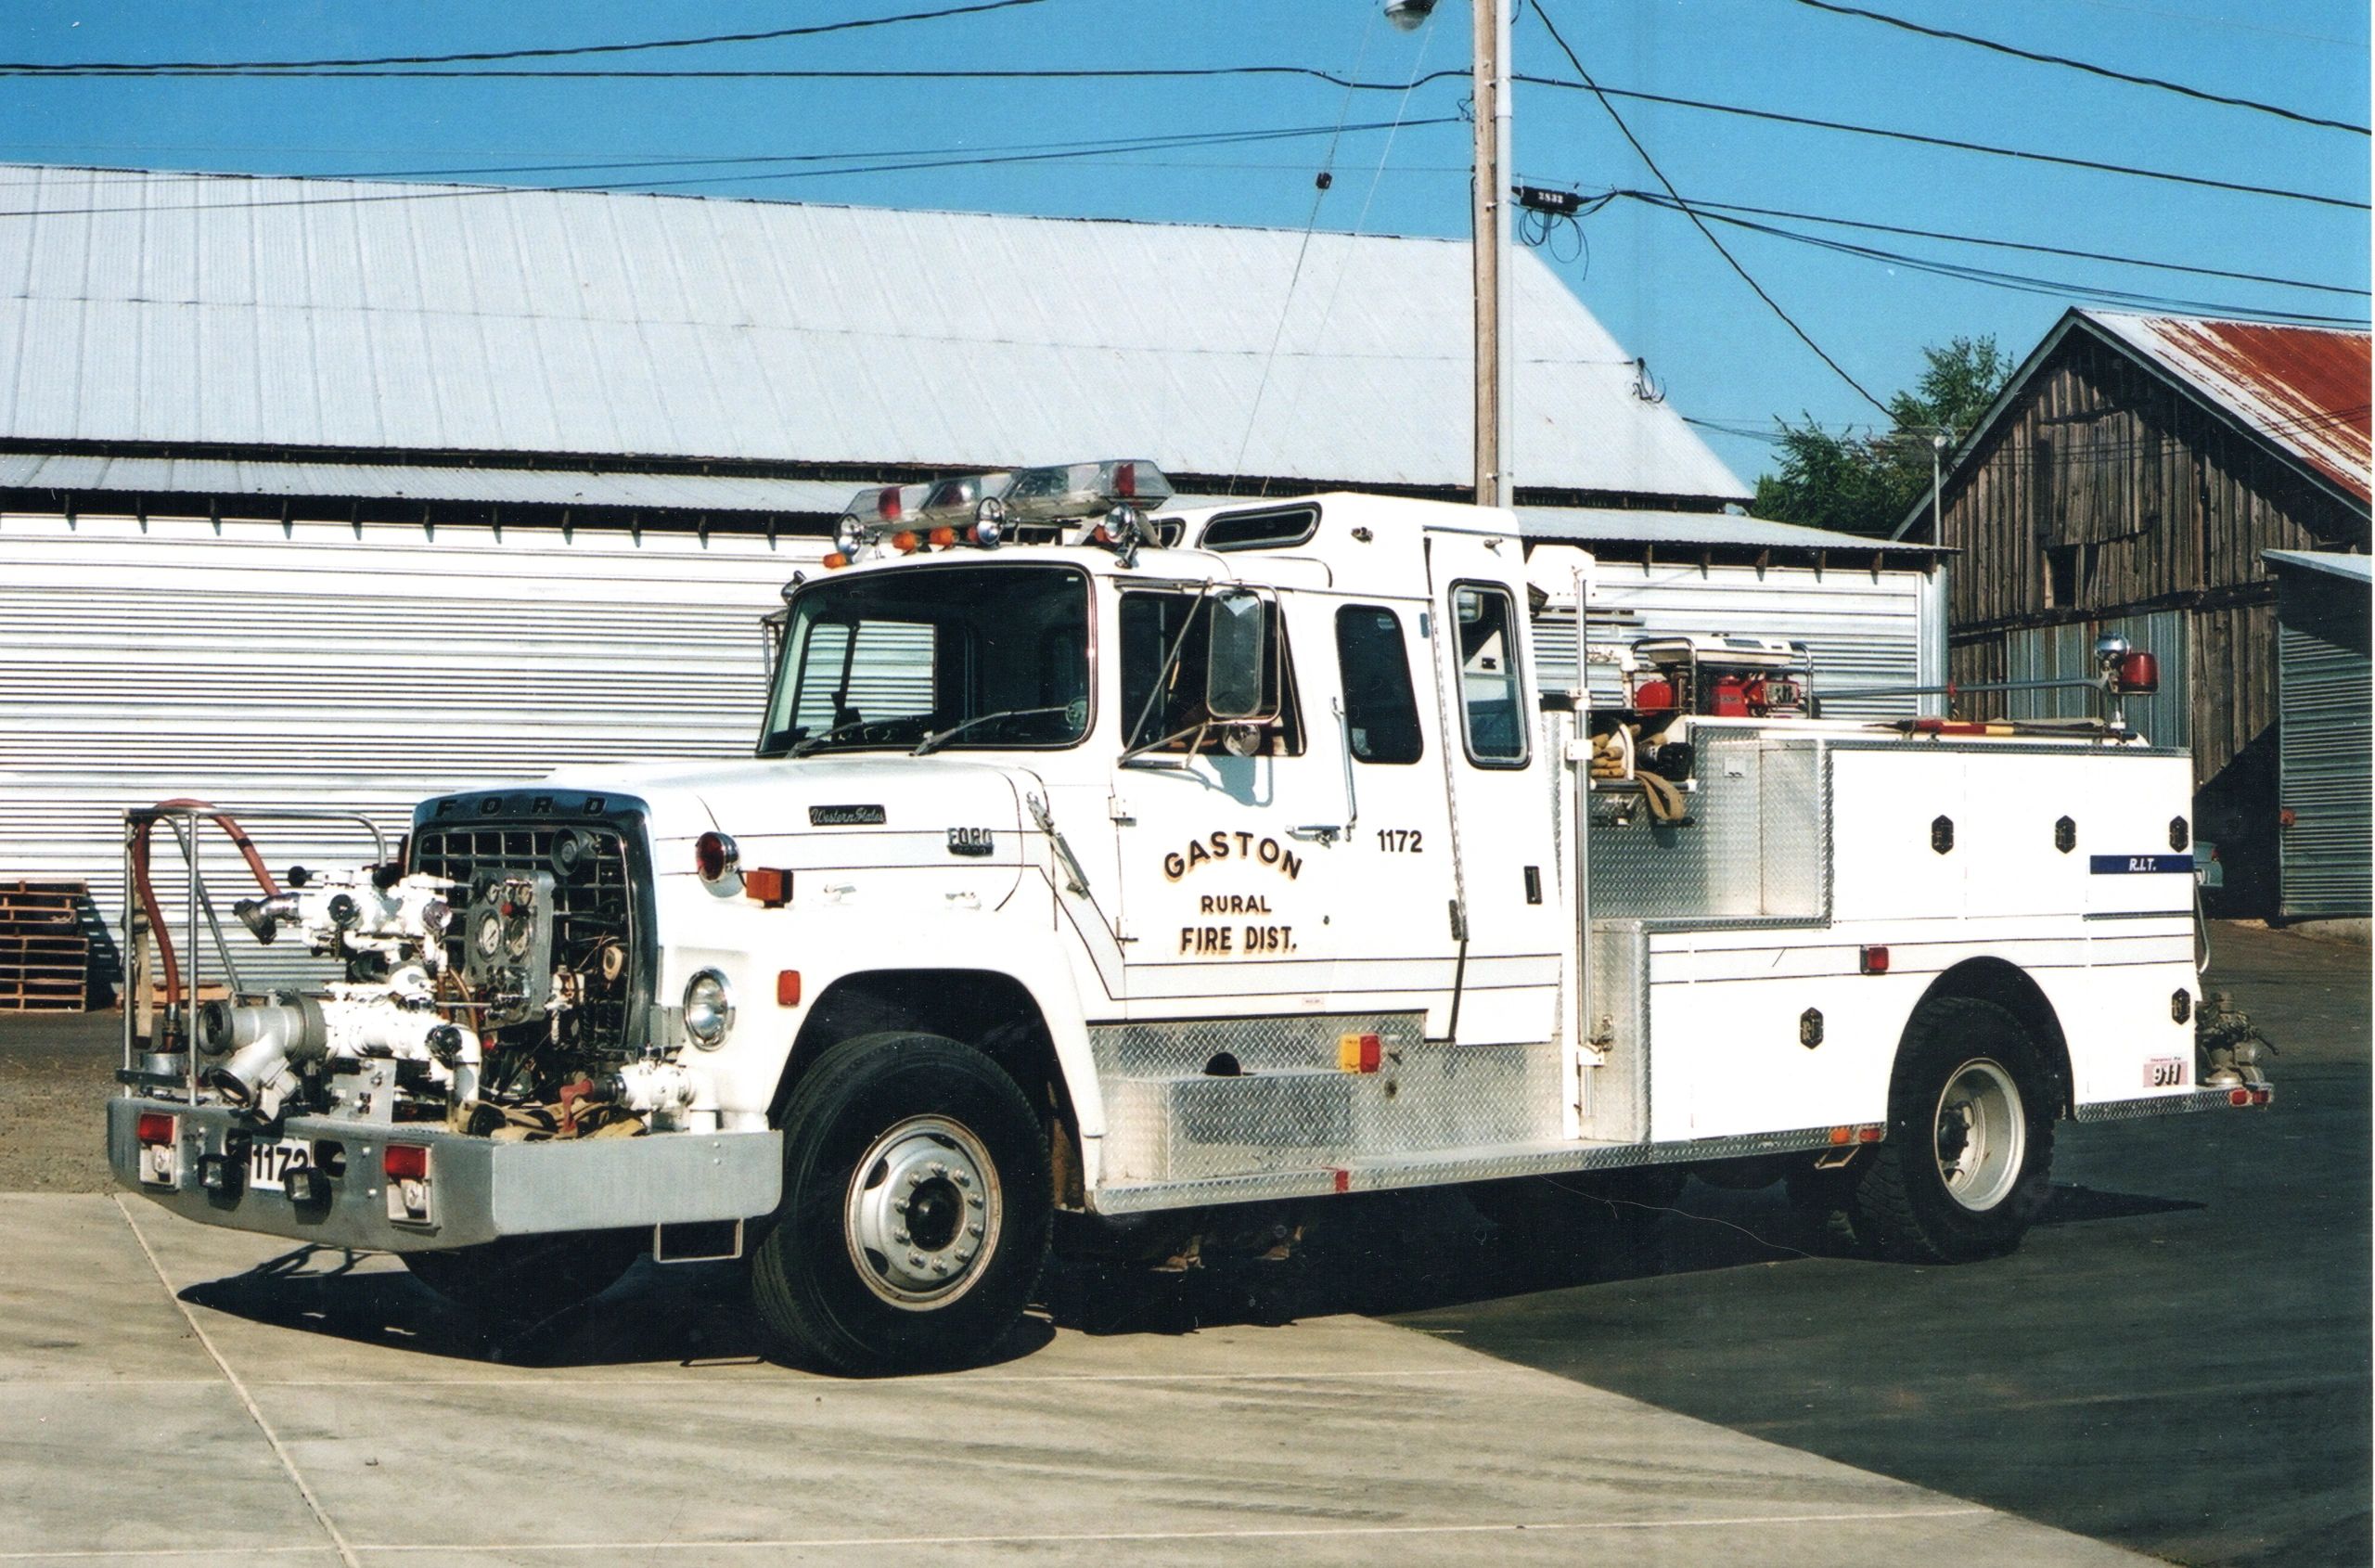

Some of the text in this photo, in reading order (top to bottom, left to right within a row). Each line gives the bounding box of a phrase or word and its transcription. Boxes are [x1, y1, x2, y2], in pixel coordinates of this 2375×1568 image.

[436, 795, 607, 817] FORD
[811, 808, 854, 823] Western
[947, 828, 993, 845] FORD
[1377, 829, 1423, 853] 1172
[1163, 831, 1303, 881] GASTON
[2129, 857, 2157, 871] R.I.T.
[1200, 894, 1272, 914] RURAL
[1179, 926, 1298, 955] FIRE DIST.
[2152, 1063, 2181, 1086] 911
[253, 1144, 309, 1183] 1172
